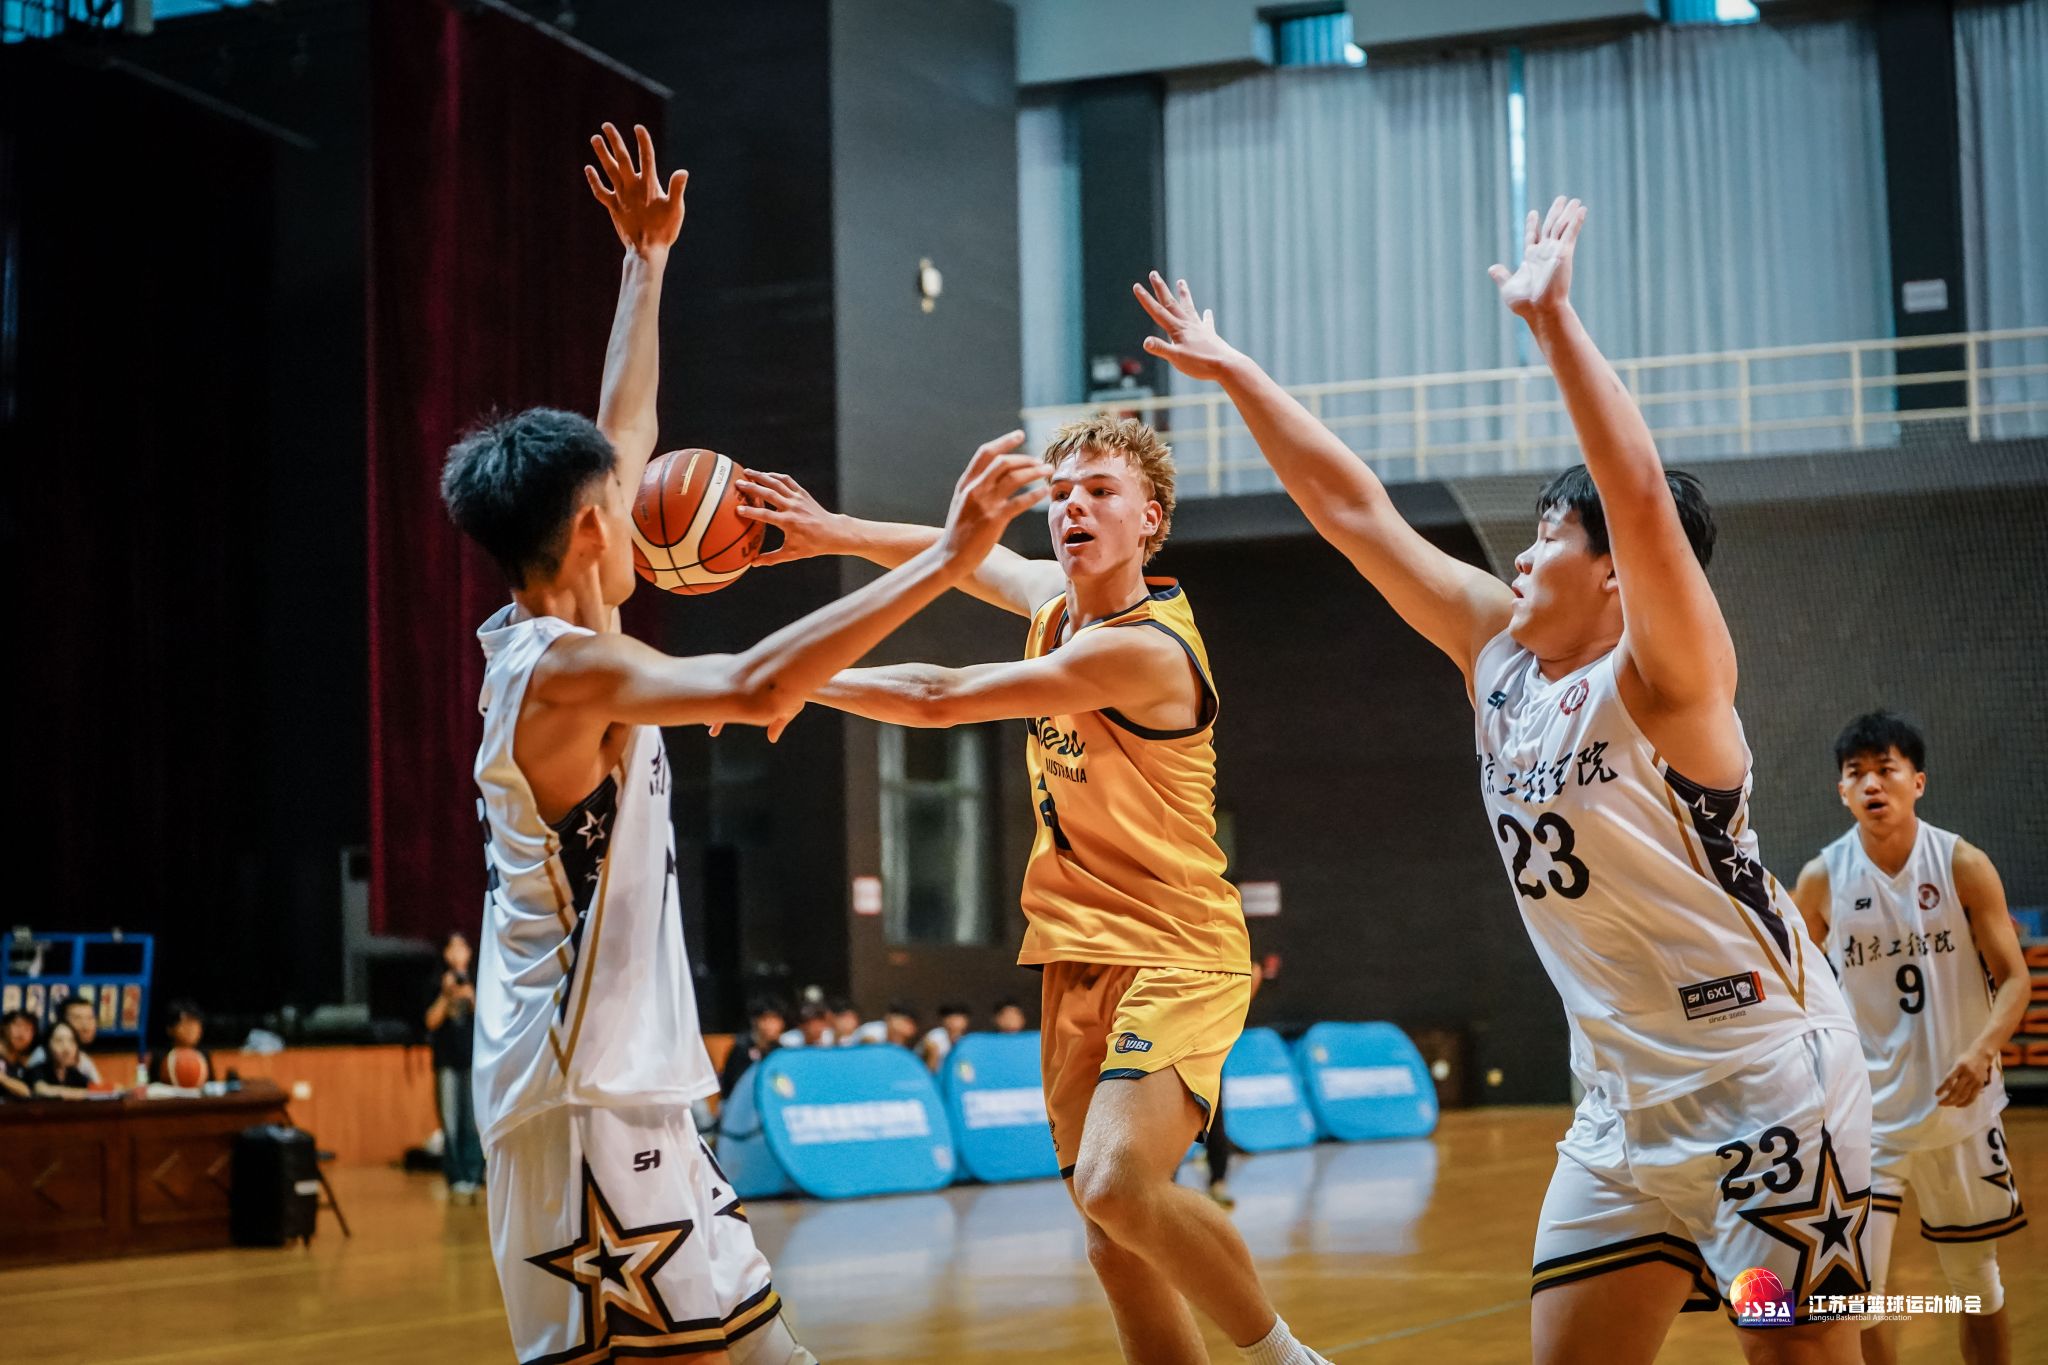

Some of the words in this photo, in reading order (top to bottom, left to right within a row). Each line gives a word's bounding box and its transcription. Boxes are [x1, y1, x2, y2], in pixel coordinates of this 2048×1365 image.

[1477, 741, 1618, 803] 京工程学院
[1497, 811, 1590, 900] 23
[1706, 986, 1731, 1000] 6XL
[1895, 963, 1926, 1015] 9
[1715, 1126, 1805, 1201] 23
